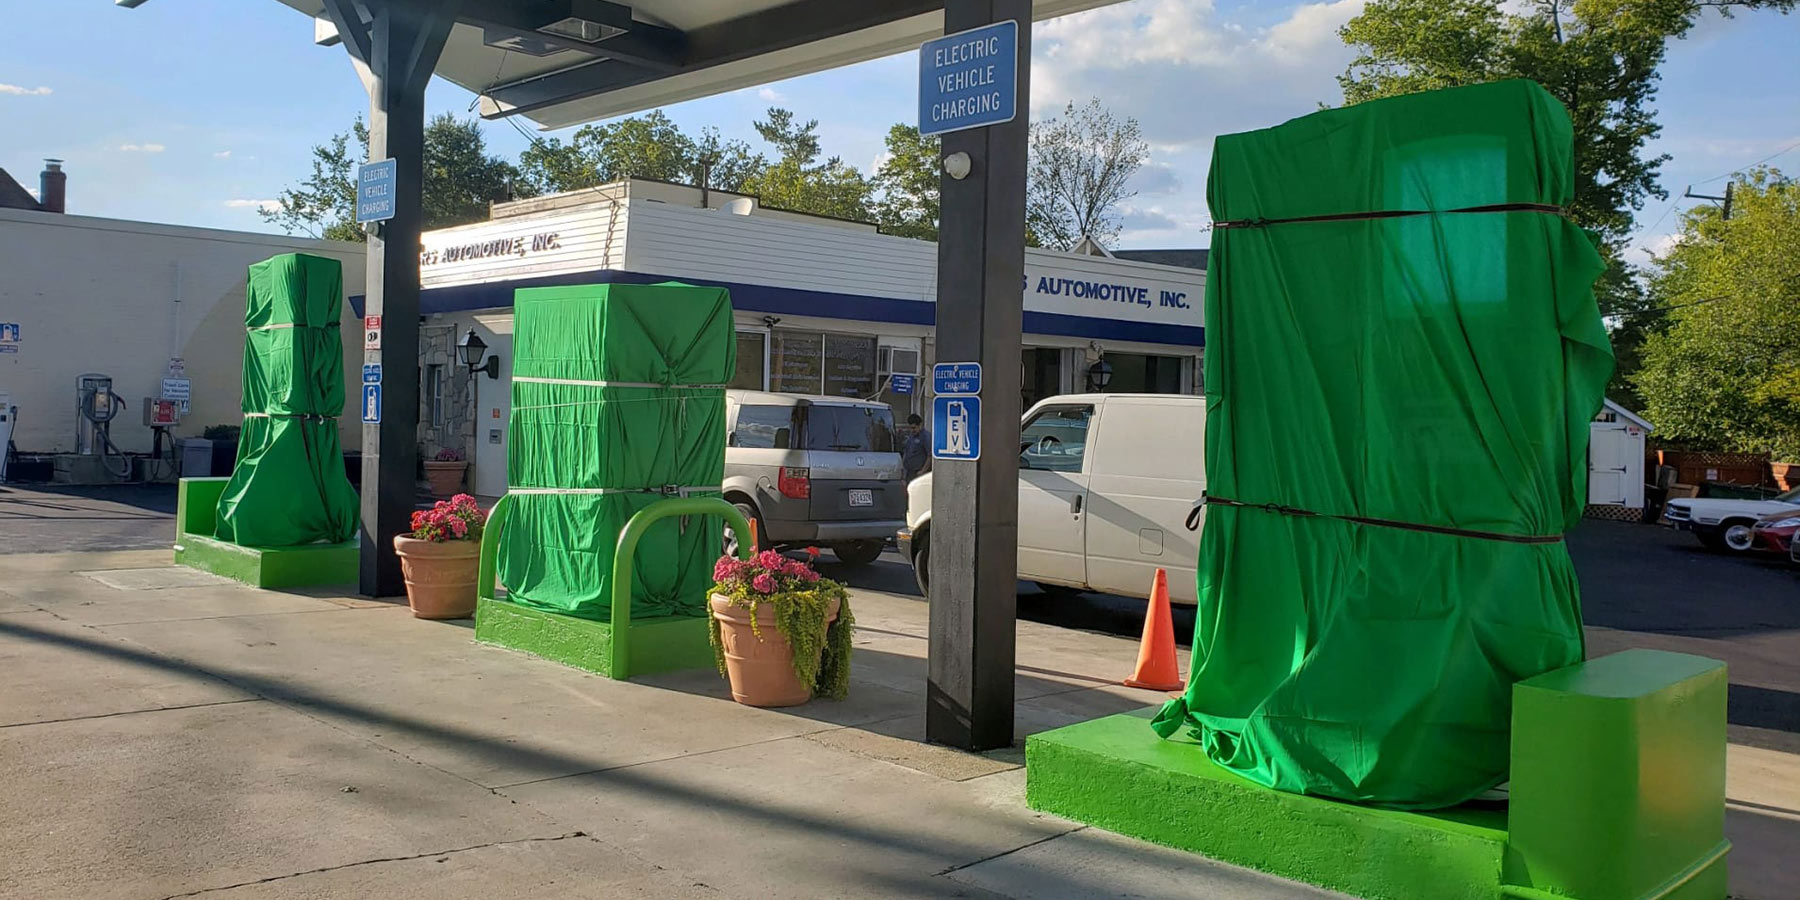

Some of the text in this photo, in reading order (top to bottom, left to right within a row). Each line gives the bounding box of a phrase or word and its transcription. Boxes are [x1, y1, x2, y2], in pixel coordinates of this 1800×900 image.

[935, 36, 999, 69] ELECTRIC
[938, 65, 995, 94] VEHICLE
[932, 92, 1000, 122] CHARGING
[364, 167, 389, 183] ELECTRIC
[365, 183, 388, 199] VEHICLE
[361, 199, 390, 215] CHARGING
[1036, 276, 1152, 309] AUTOMOTIVE,
[1159, 290, 1190, 310] INC.
[935, 369, 978, 379] ELECTRIC VEHICLE
